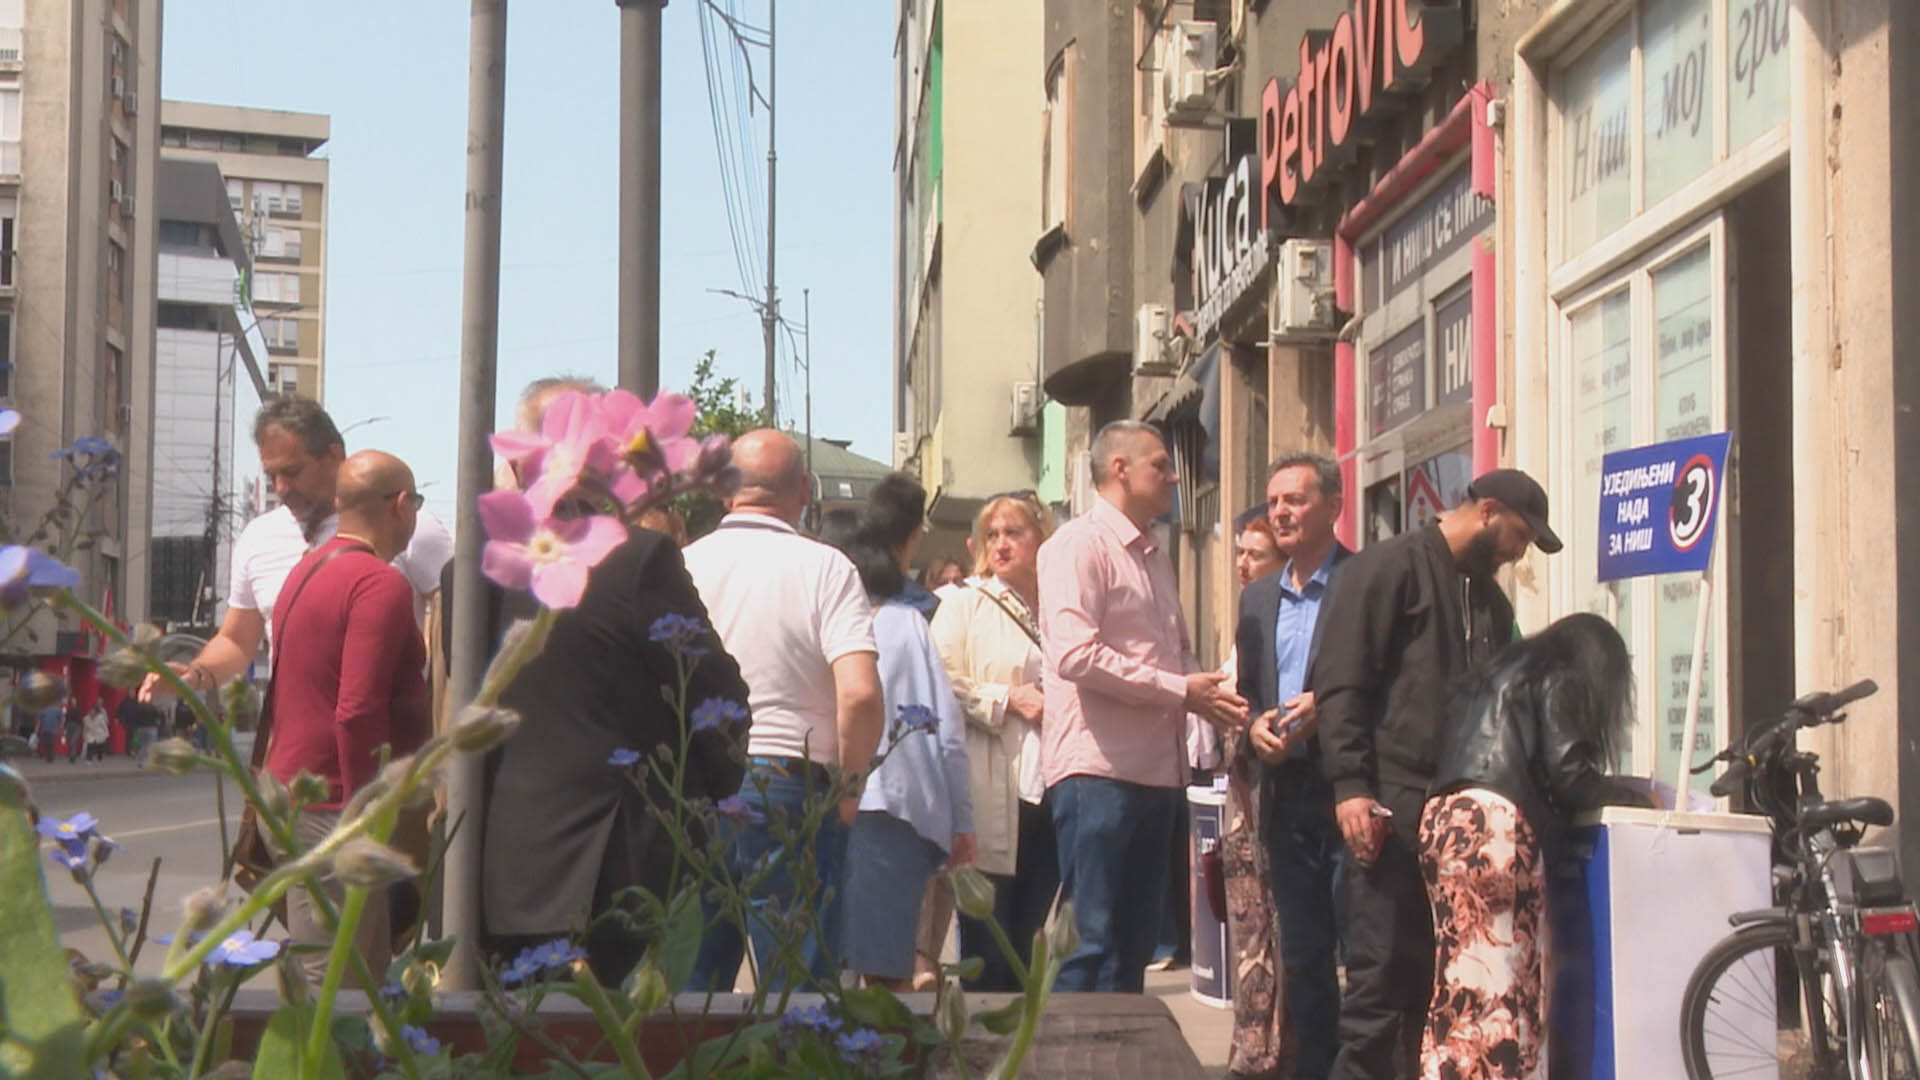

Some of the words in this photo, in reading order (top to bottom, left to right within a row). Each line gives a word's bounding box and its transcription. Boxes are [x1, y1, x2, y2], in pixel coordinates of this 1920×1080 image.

[1602, 460, 1676, 498] УЈЕДИЊЕНИ
[1617, 496, 1650, 526] НАДА
[1675, 466, 1707, 539] 3
[1608, 532, 1623, 557] ЗА
[1624, 527, 1654, 554] НИШ
